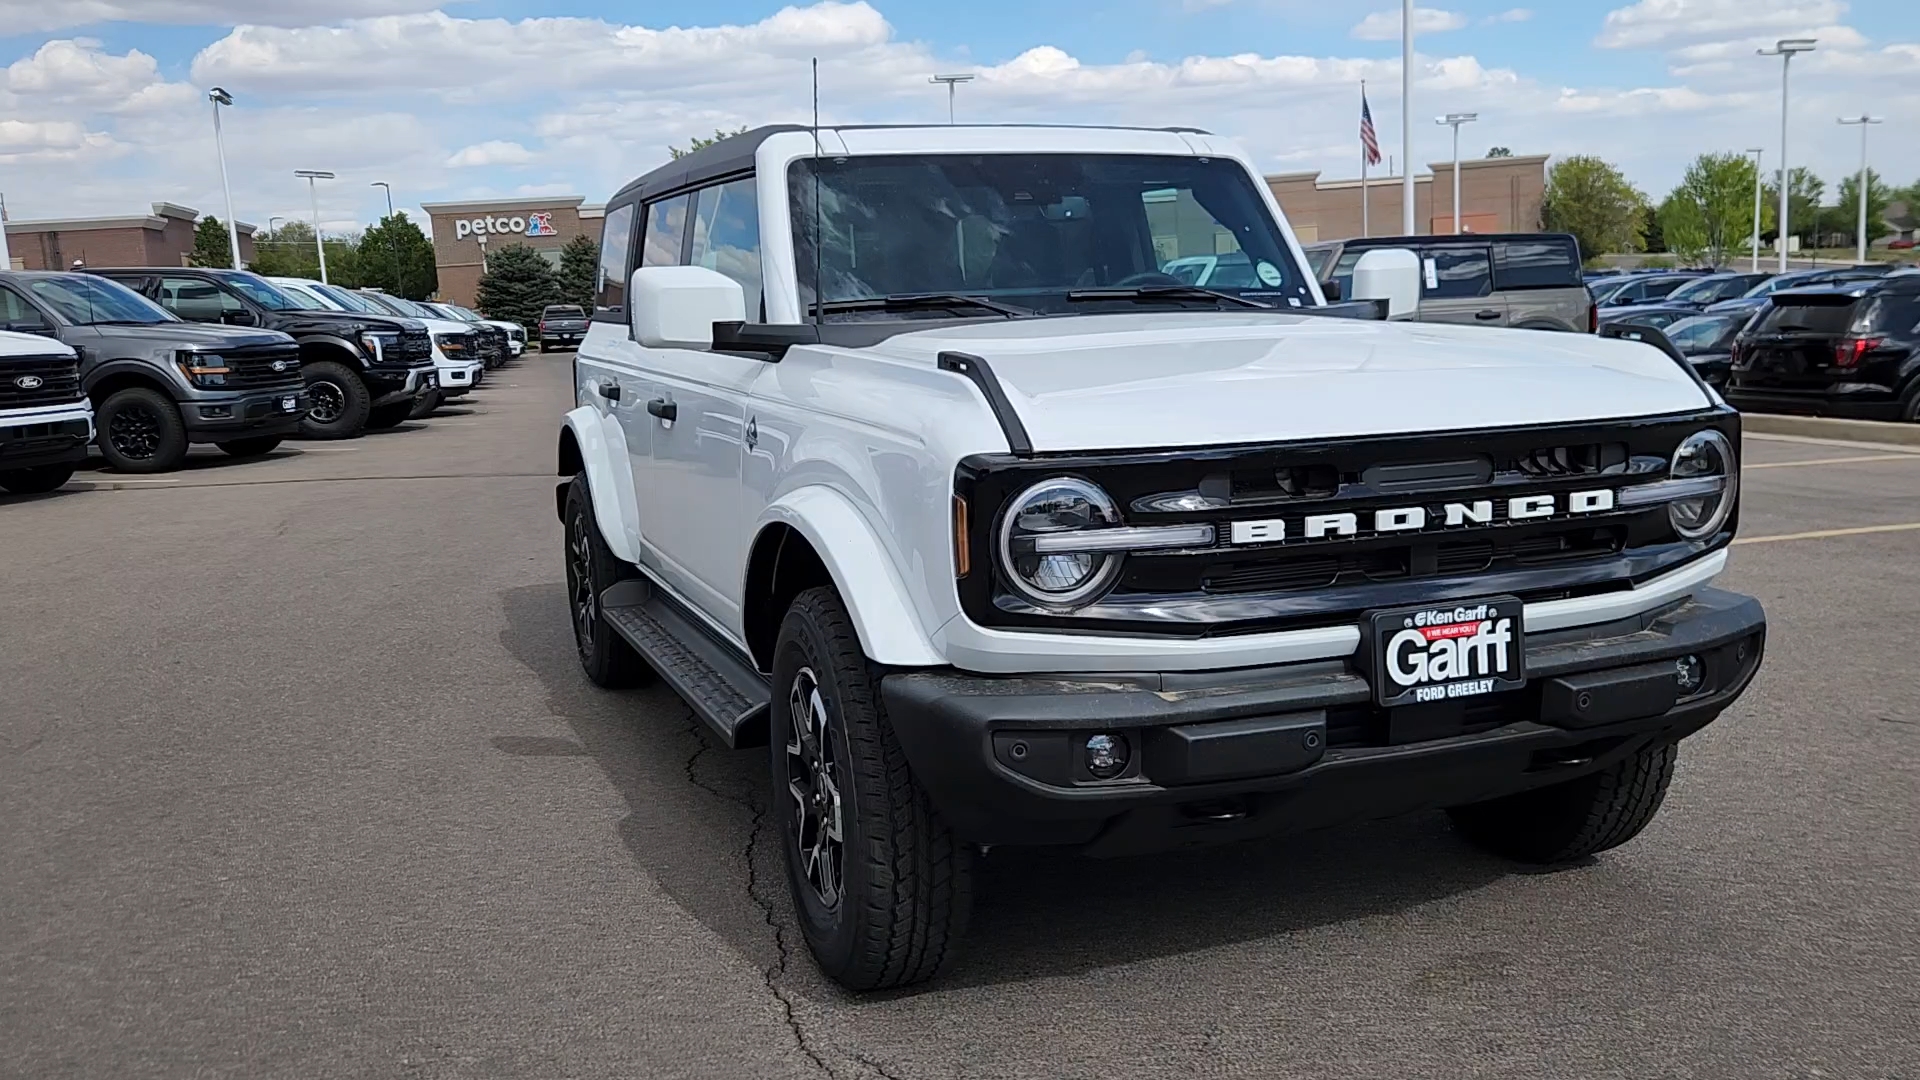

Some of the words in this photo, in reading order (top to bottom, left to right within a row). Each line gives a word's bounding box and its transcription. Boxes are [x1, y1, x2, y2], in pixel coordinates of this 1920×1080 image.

[455, 215, 526, 241] petco
[1231, 489, 1614, 544] BRONCO
[1427, 610, 1453, 626] Ken
[1454, 605, 1488, 622] Garff
[1431, 629, 1441, 637] WE
[1442, 627, 1459, 636] HEAR
[1459, 626, 1472, 634] YOU
[1386, 618, 1511, 687] Garff
[1416, 685, 1446, 702] FORD
[1447, 679, 1494, 698] GREELEY
